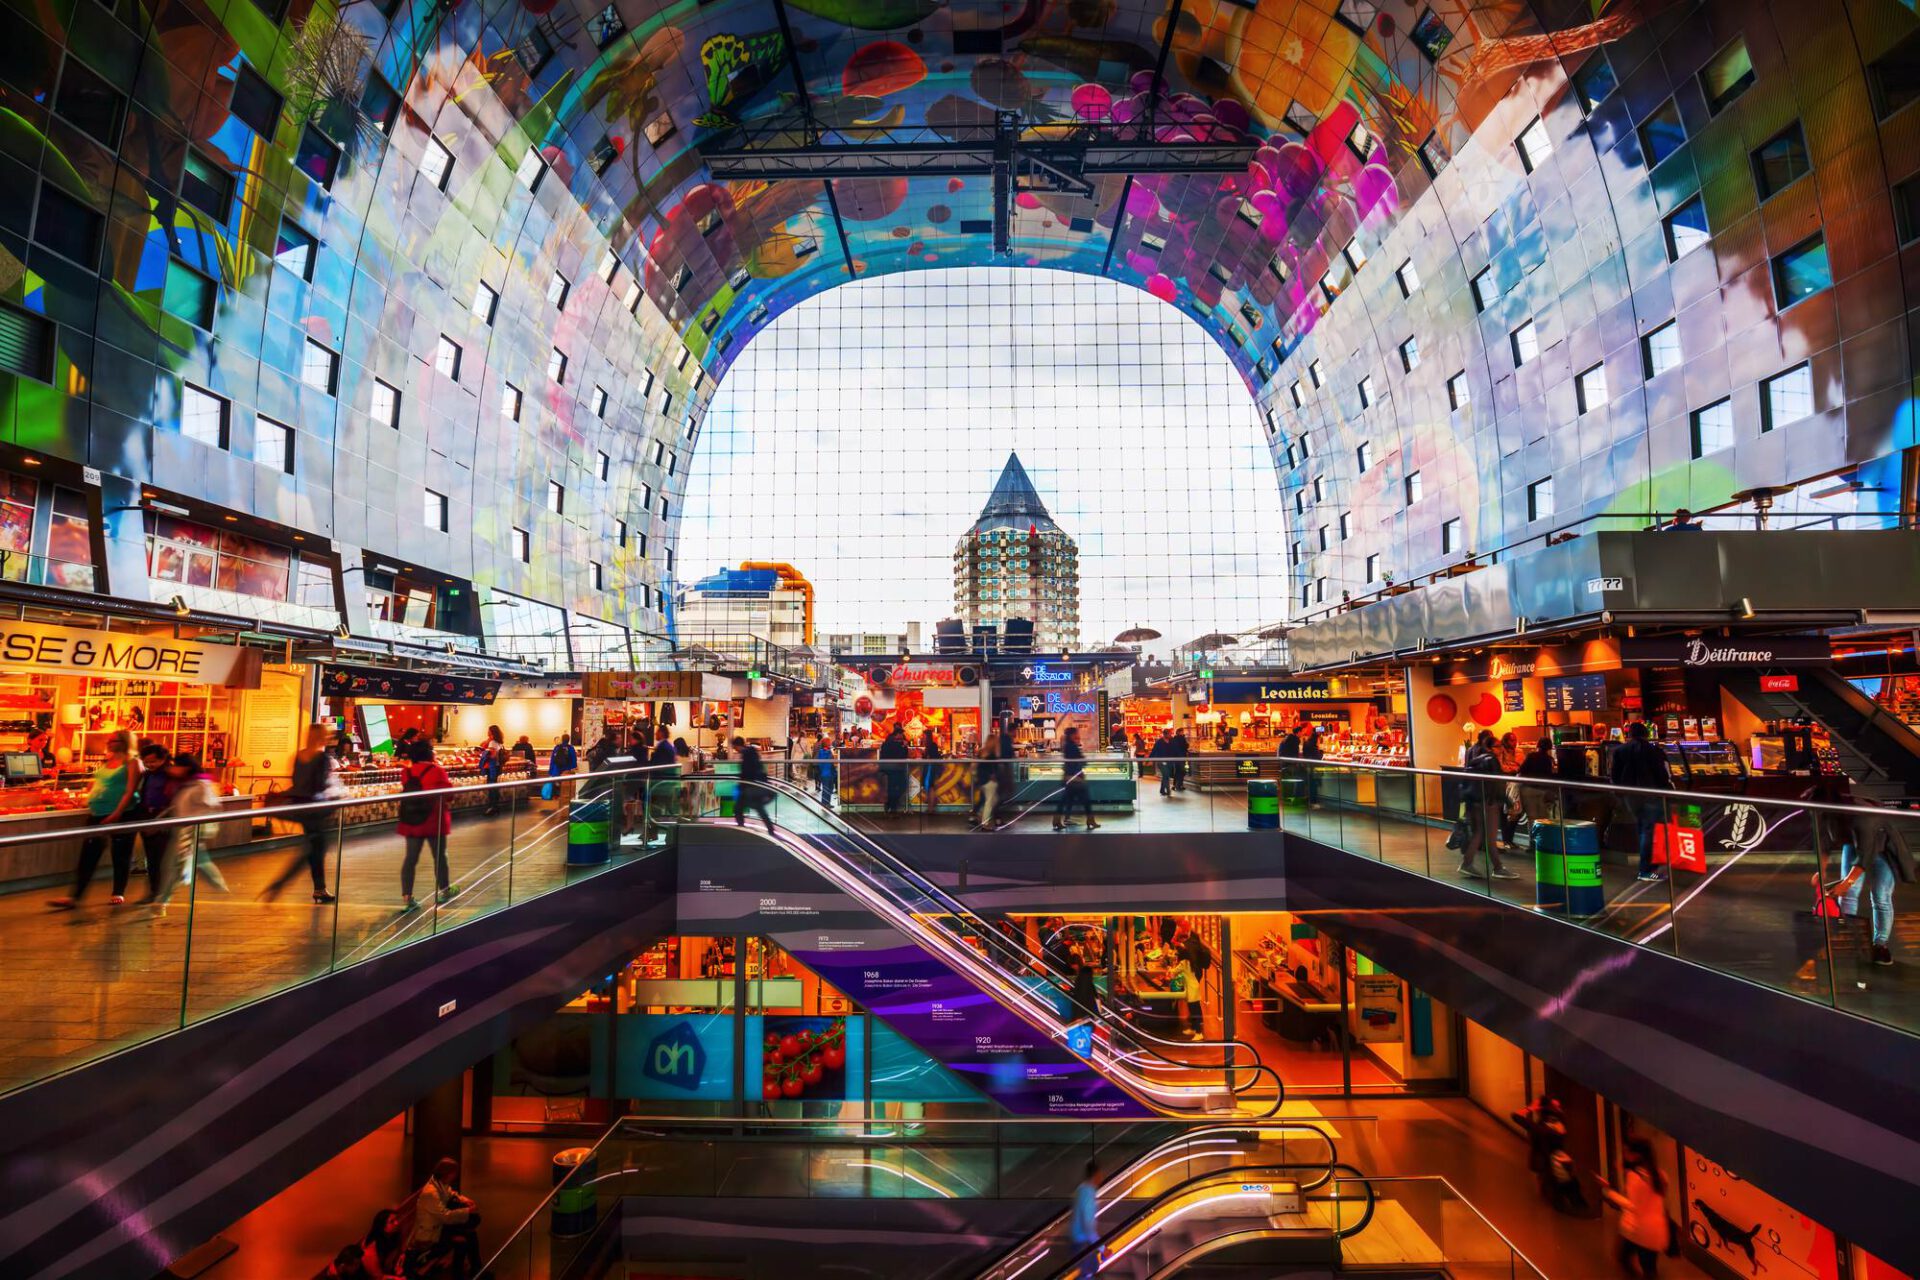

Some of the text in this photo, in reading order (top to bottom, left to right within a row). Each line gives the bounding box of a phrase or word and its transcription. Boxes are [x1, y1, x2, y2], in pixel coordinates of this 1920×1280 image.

[85, 471, 100, 481] 209
[1604, 579, 1621, 588] 77
[0, 632, 203, 674] SE & MORE
[1684, 638, 1773, 665] Délifrance
[892, 664, 953, 680] Churros
[1034, 665, 1046, 673] DE
[1261, 686, 1329, 699] Leonidas
[1047, 693, 1061, 702] DE
[760, 898, 777, 906] 2000
[864, 971, 880, 979] 1968
